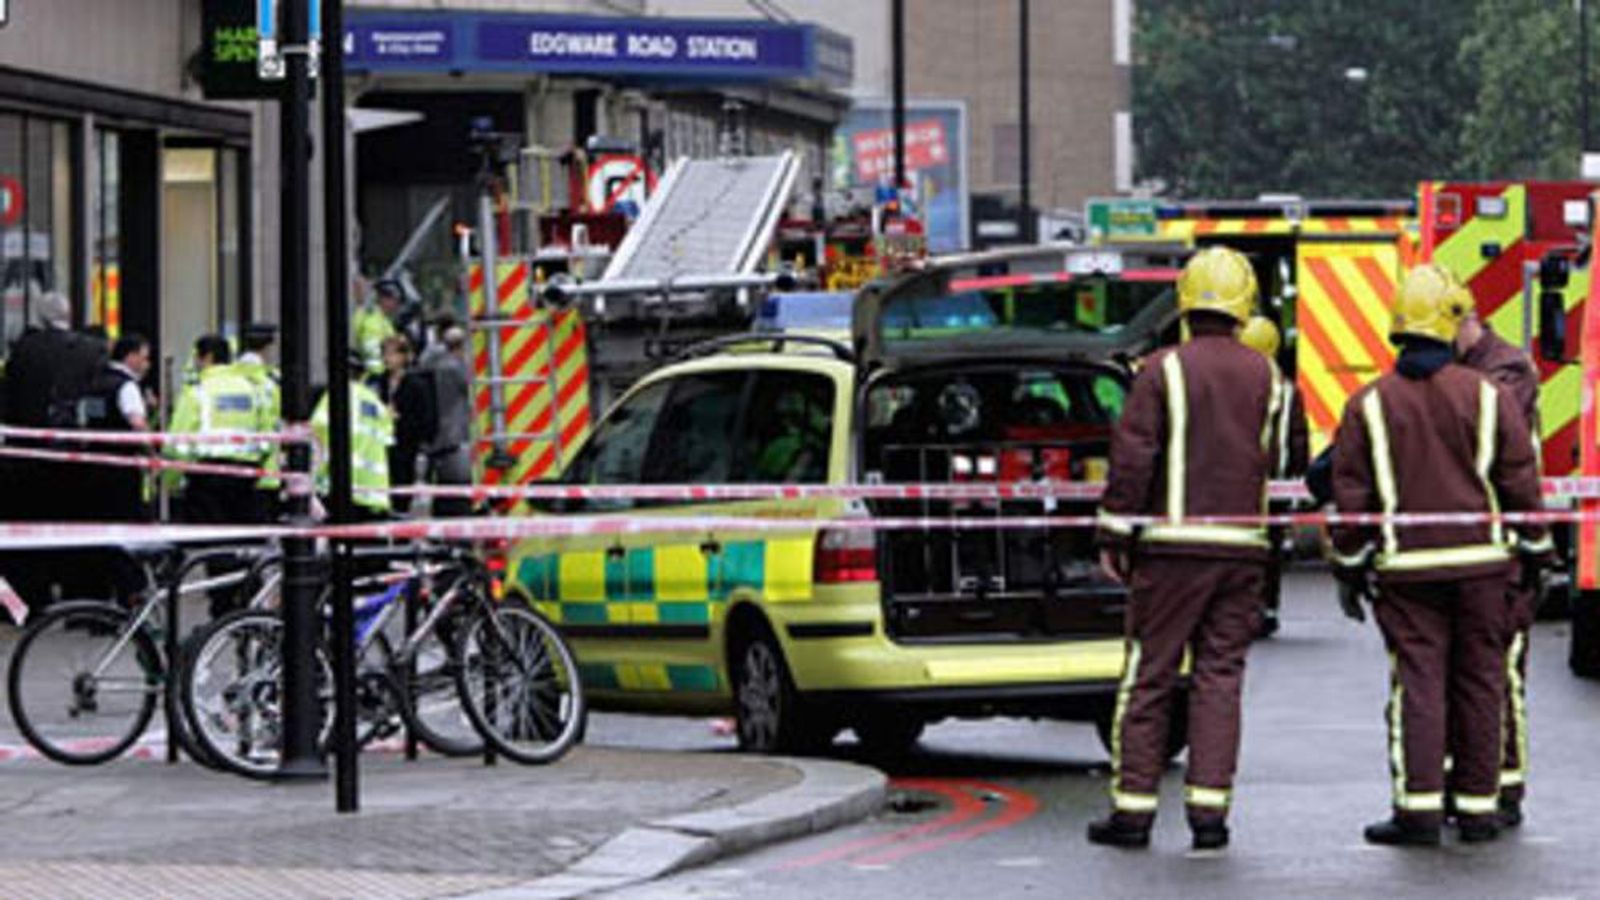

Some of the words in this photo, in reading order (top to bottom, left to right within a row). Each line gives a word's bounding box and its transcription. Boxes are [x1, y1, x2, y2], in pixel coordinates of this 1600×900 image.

[531, 31, 617, 56] EDGWARE
[627, 34, 677, 57] ROAD
[687, 36, 757, 59] STATION
